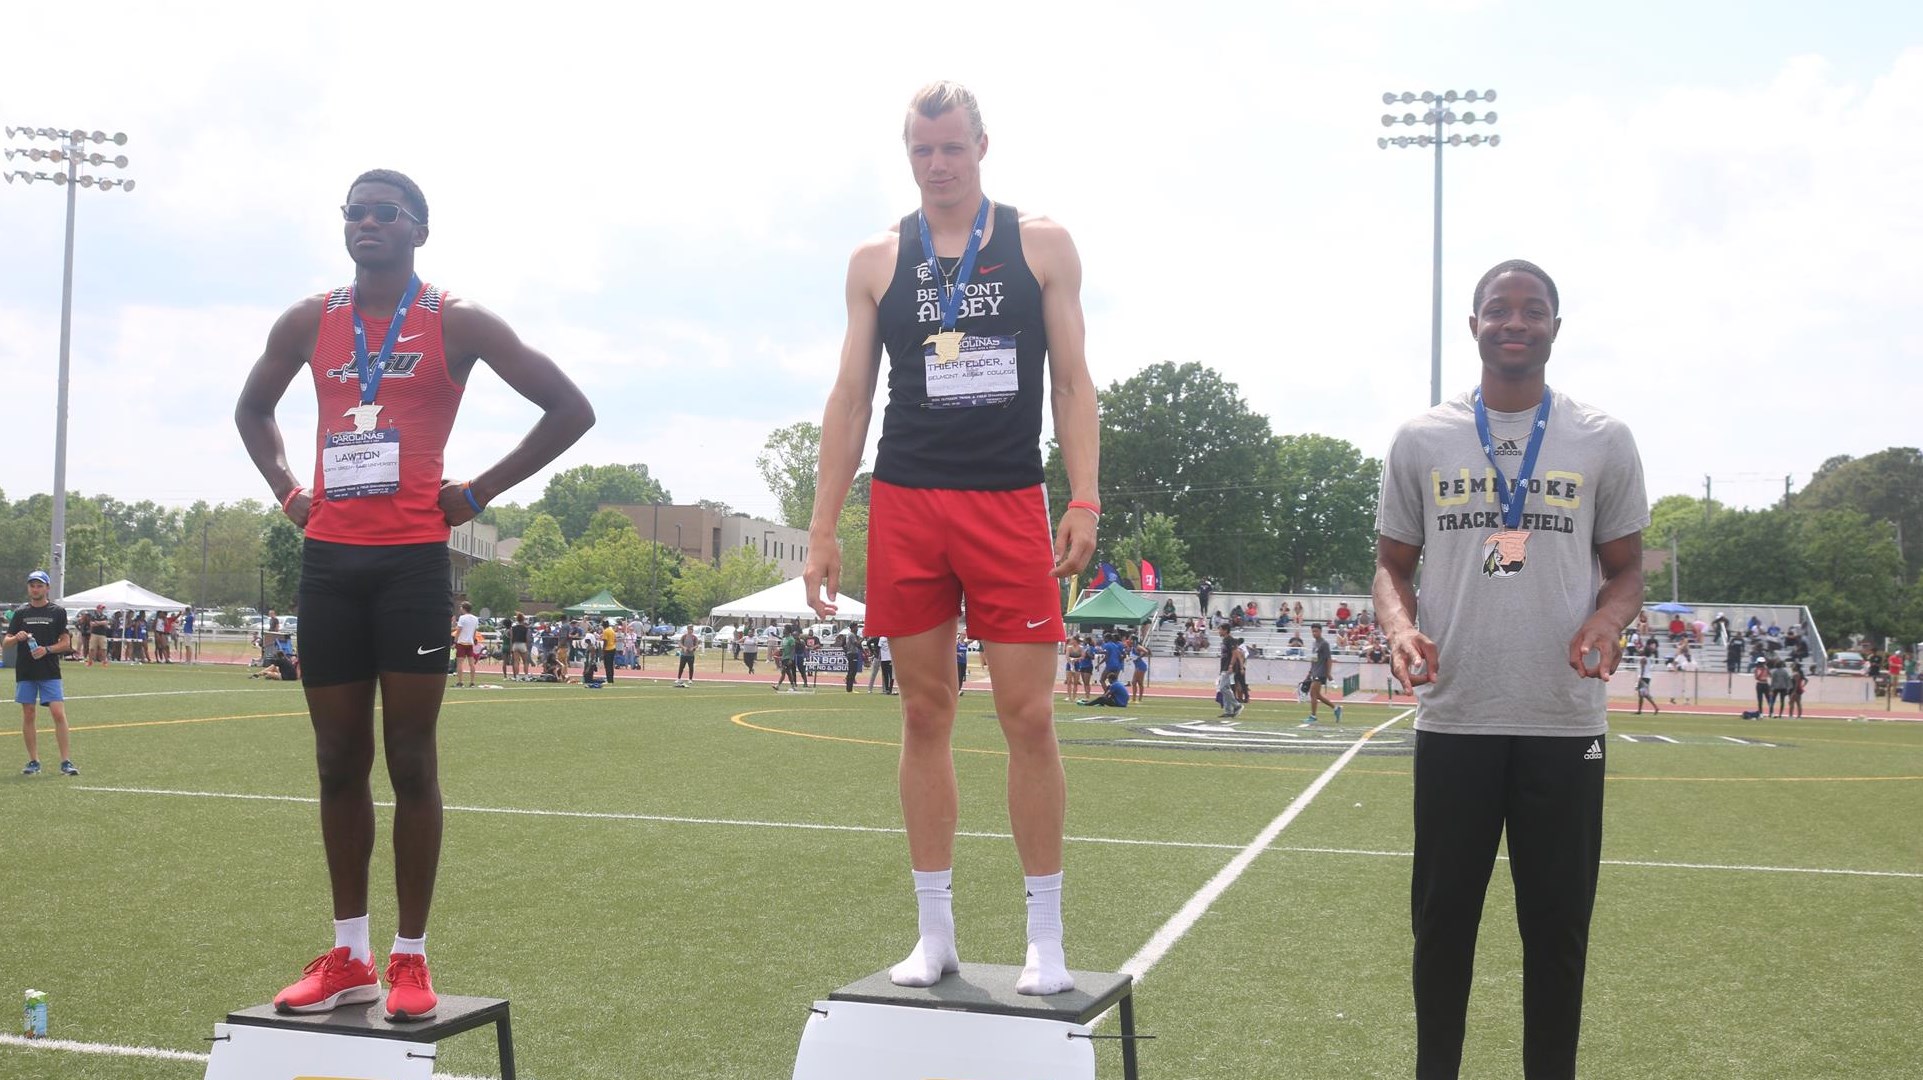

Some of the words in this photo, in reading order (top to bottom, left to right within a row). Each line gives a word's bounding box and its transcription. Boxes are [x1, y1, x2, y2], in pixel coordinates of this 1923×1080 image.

[916, 282, 1003, 302] BEONT
[928, 358, 1003, 371] THIERFELDER,
[1009, 357, 1016, 365] J
[332, 432, 385, 444] CAROLINAS
[335, 450, 380, 463] LAWTON
[1494, 448, 1522, 456] adidas
[1437, 511, 1499, 531] TRACK
[1521, 512, 1575, 534] FIELD
